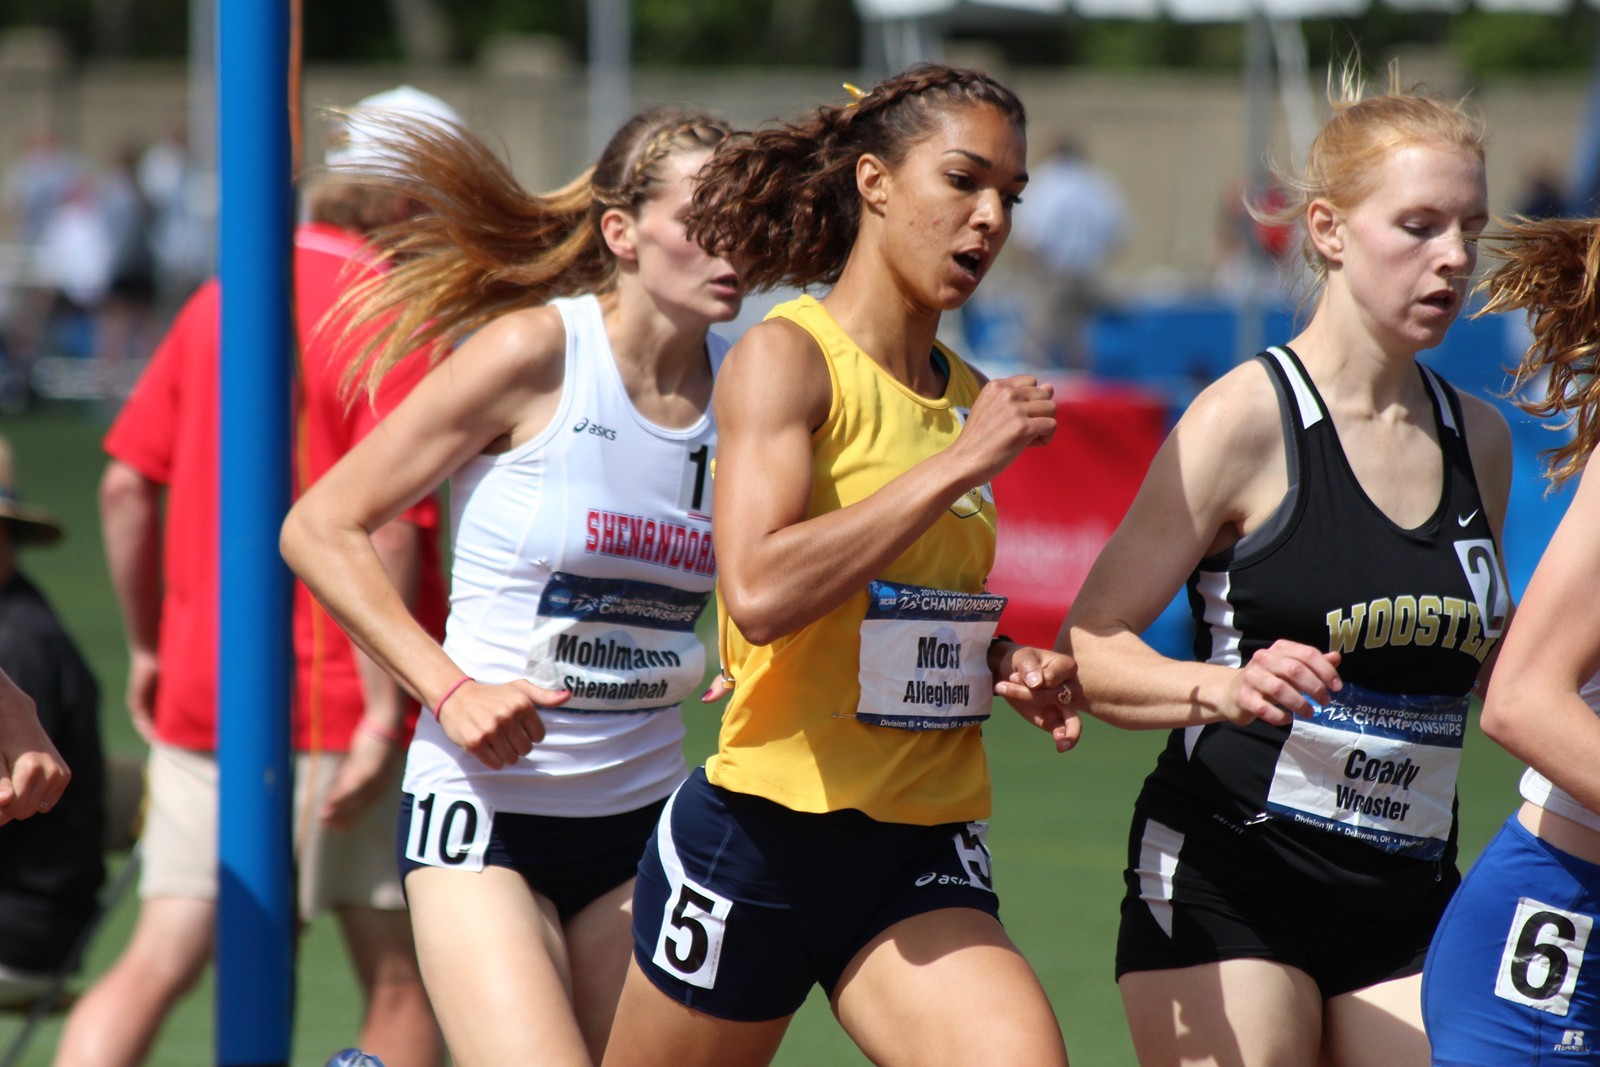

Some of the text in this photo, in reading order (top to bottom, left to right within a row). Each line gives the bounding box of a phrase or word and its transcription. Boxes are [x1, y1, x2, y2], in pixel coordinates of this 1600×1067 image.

[588, 423, 617, 441] asics
[920, 589, 937, 597] 2014
[1467, 545, 1505, 631] 2
[600, 603, 694, 622] CHAMPIONSHIPS
[921, 597, 1004, 611] CHAMPIONSHIPS
[555, 634, 681, 671] Mohlmann
[917, 636, 961, 669] Moss
[563, 675, 668, 700] Shenandoah
[903, 681, 970, 707] Allegheny
[880, 719, 907, 728] Division
[1353, 712, 1461, 737] CHAMPIONSHIPS
[1355, 704, 1378, 714] 2014
[1378, 708, 1420, 719] OUTDOOR
[1444, 713, 1463, 722] FIELD
[1343, 748, 1420, 790] Coady
[1335, 784, 1410, 822] Wooster
[417, 793, 477, 865] 10
[1294, 814, 1325, 828] Division
[1344, 828, 1379, 843] Delaware,
[1380, 835, 1391, 844] OH
[664, 883, 716, 974] 5
[1510, 911, 1576, 1000] 6
